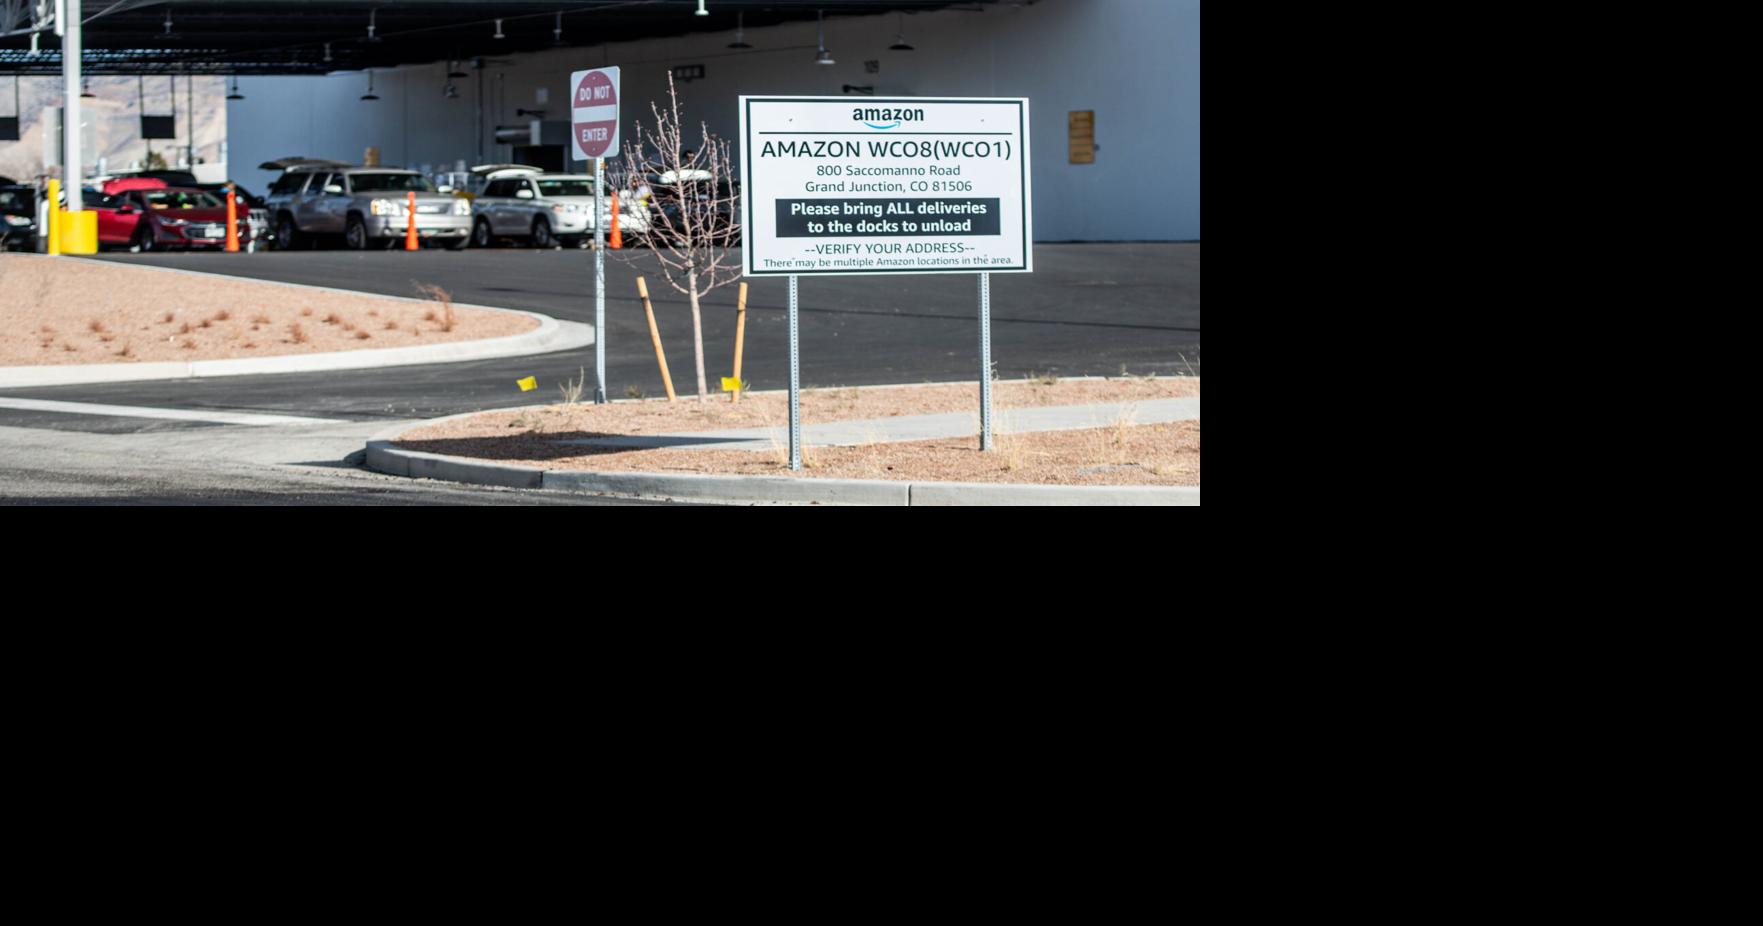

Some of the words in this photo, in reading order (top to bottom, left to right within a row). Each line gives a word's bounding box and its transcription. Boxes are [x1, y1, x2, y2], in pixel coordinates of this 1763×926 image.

[580, 88, 592, 101] DO
[594, 86, 610, 99] NOT
[853, 108, 924, 121] amazon
[582, 128, 608, 142] ENTER
[761, 141, 860, 158] AMAZON
[816, 165, 842, 176] 800
[846, 165, 925, 176] Saccomanno
[930, 165, 960, 176] Road
[805, 181, 845, 192] Grand
[849, 181, 906, 193] Junction,
[910, 181, 928, 192] CO
[932, 181, 972, 192] 81506
[791, 203, 839, 216] Please
[844, 202, 882, 218] bring
[886, 202, 914, 215] ALL
[917, 201, 987, 215] deliveries
[808, 221, 823, 233] to
[828, 221, 852, 233] the
[856, 220, 899, 232] docks
[902, 221, 917, 232] to
[921, 219, 971, 232] unload
[865, 243, 902, 254] YOUR
[764, 258, 792, 268] There
[795, 259, 815, 269] may
[818, 258, 831, 267] be
[834, 258, 873, 269] multiple
[876, 258, 914, 267] Amazon
[917, 257, 959, 266] locations
[962, 257, 971, 265] in
[973, 256, 989, 265] the
[991, 256, 1014, 265] area.
